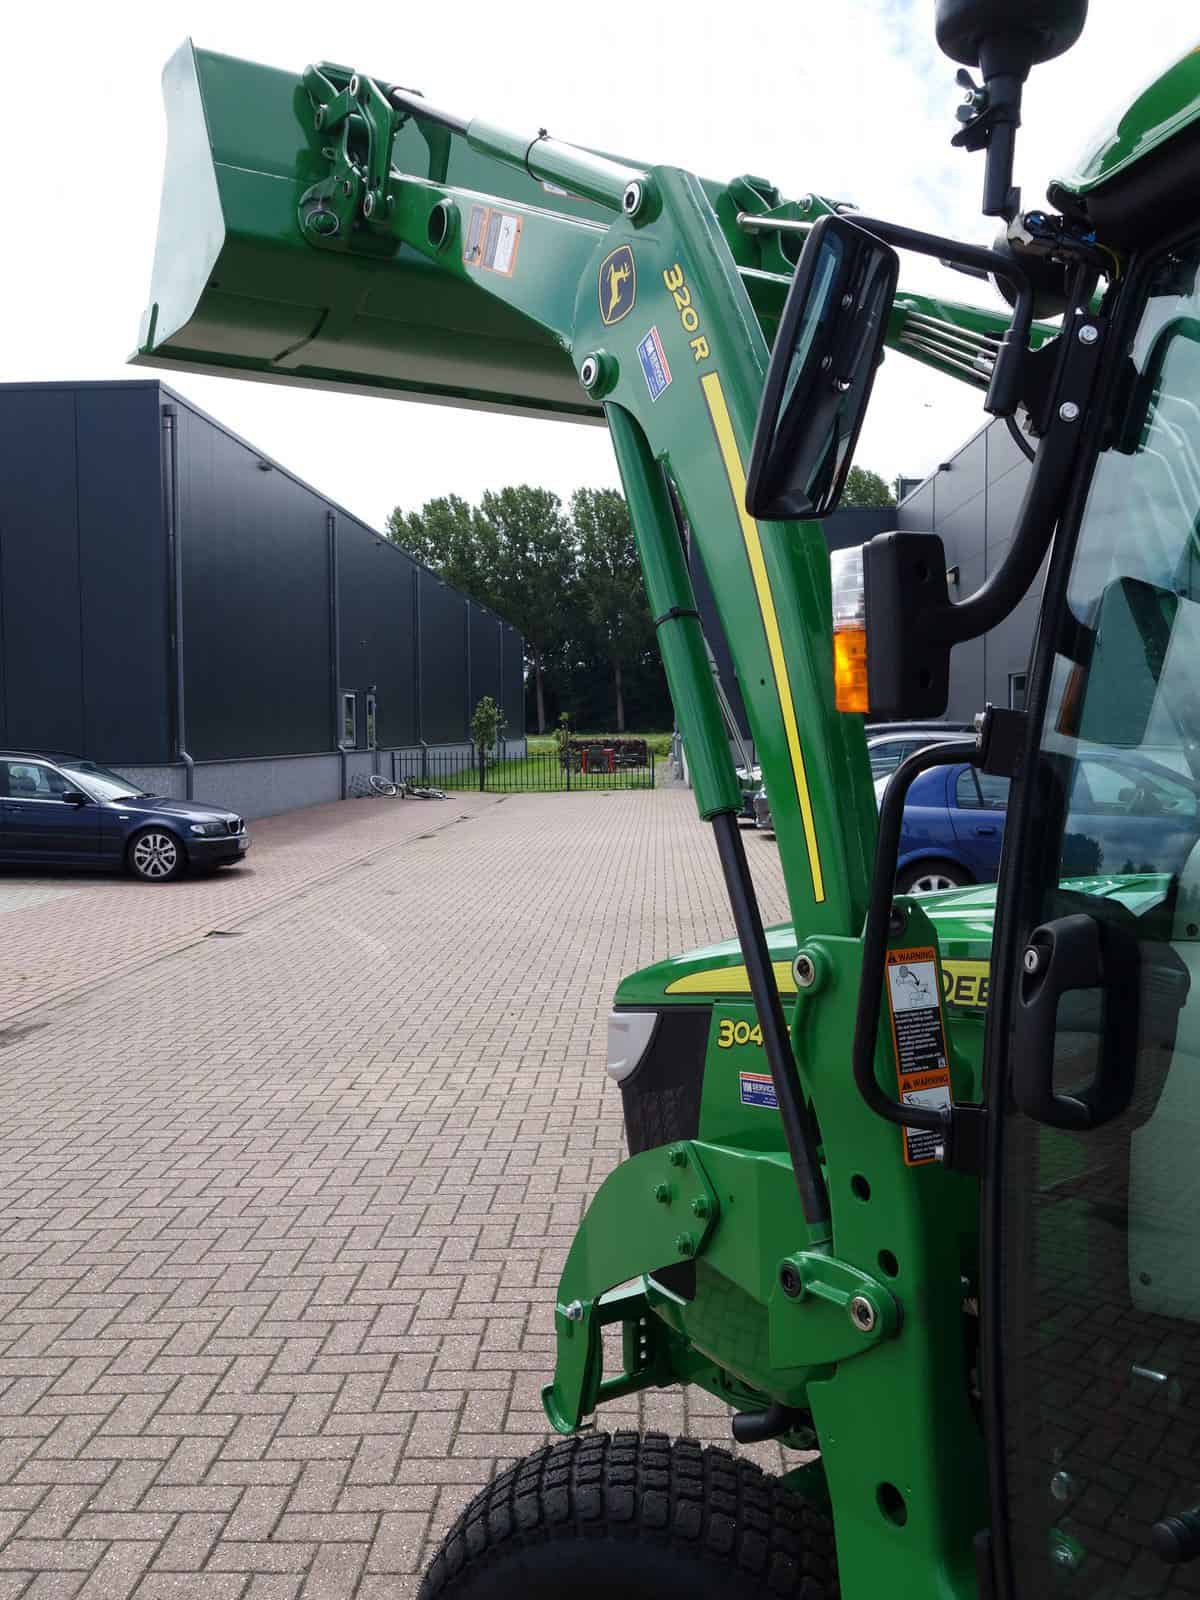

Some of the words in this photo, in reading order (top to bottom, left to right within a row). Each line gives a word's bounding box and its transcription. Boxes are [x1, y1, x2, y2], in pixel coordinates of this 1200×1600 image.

[663, 263, 699, 333] 320
[688, 335, 711, 363] R
[898, 950, 934, 961] WARNING
[913, 1076, 948, 1087] WARNING
